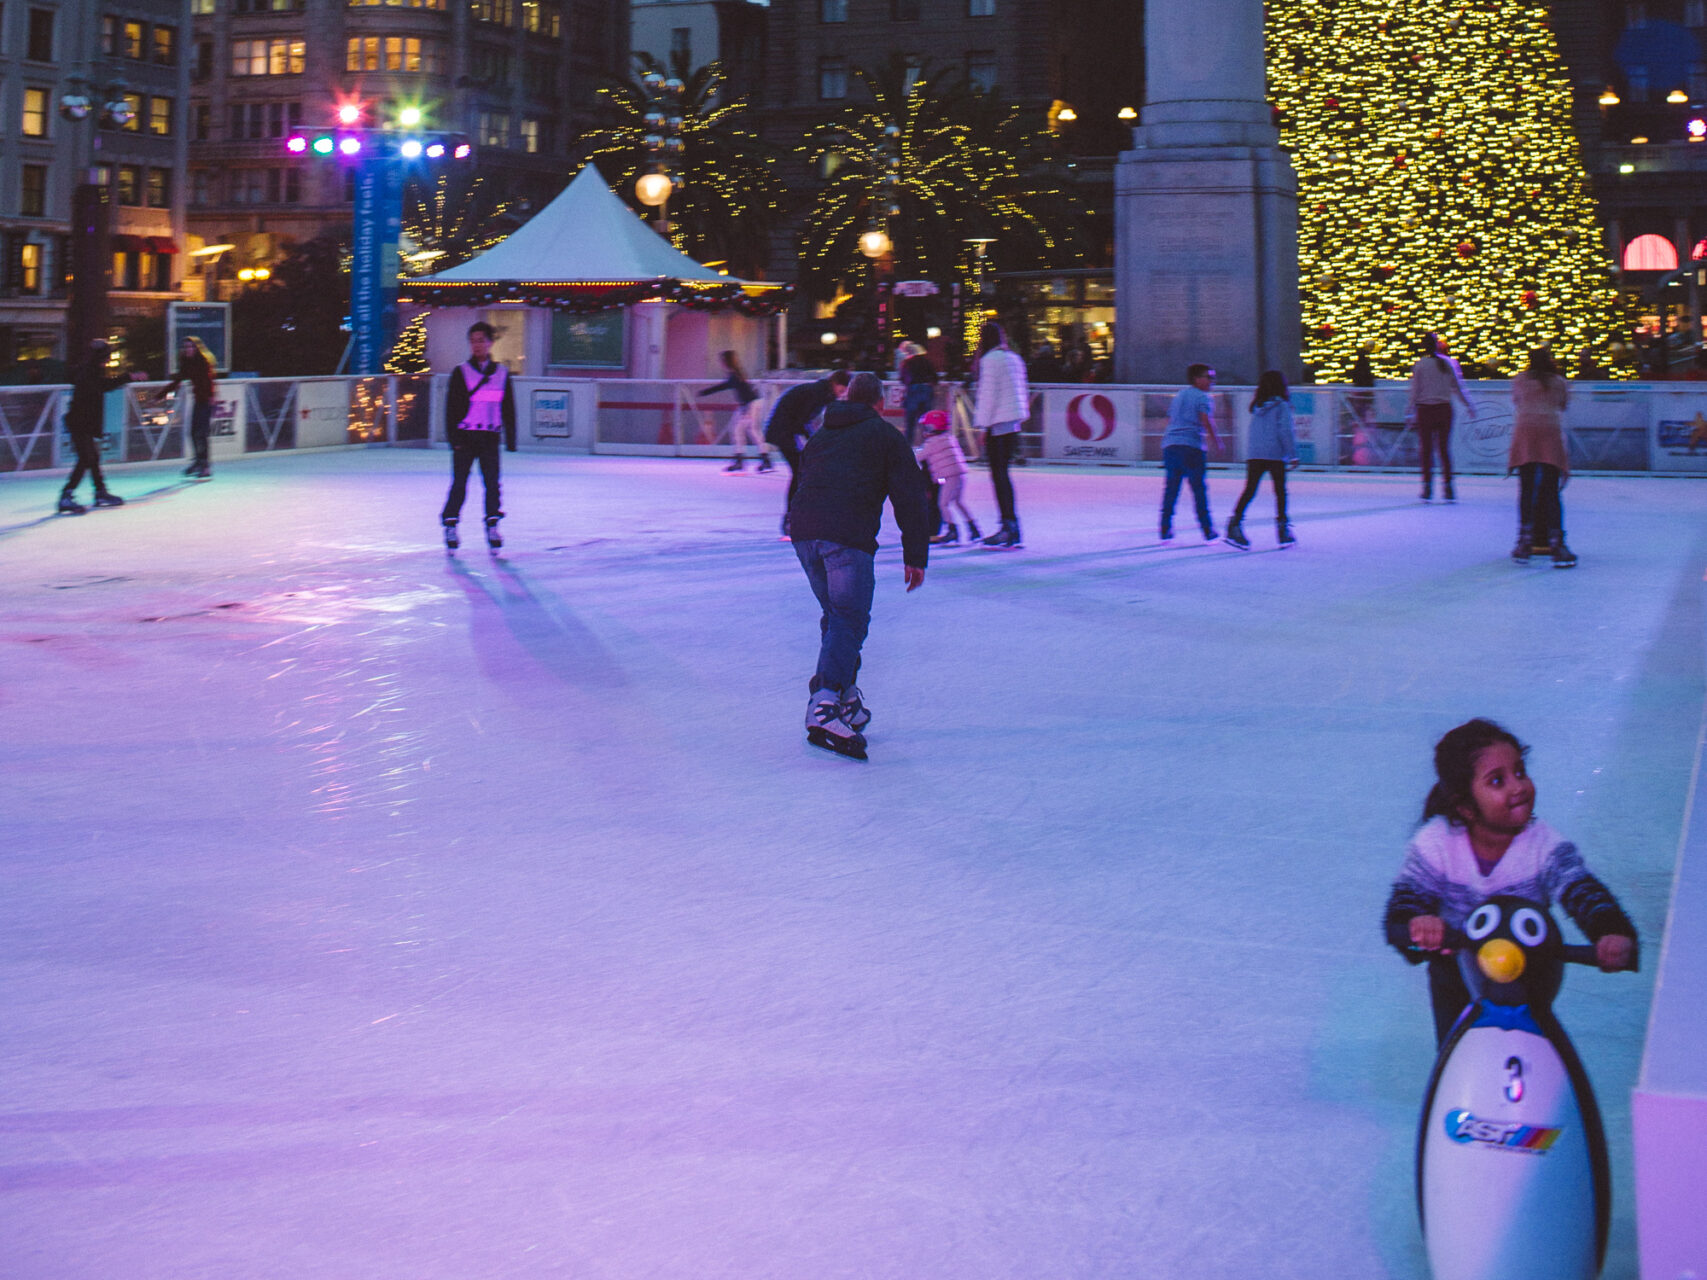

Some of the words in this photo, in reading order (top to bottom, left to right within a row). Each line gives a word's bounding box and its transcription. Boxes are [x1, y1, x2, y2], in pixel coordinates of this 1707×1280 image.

[358, 219, 376, 273] holiday
[357, 277, 371, 301] the
[357, 304, 371, 322] all
[358, 324, 371, 341] to
[1503, 1055, 1523, 1103] 3
